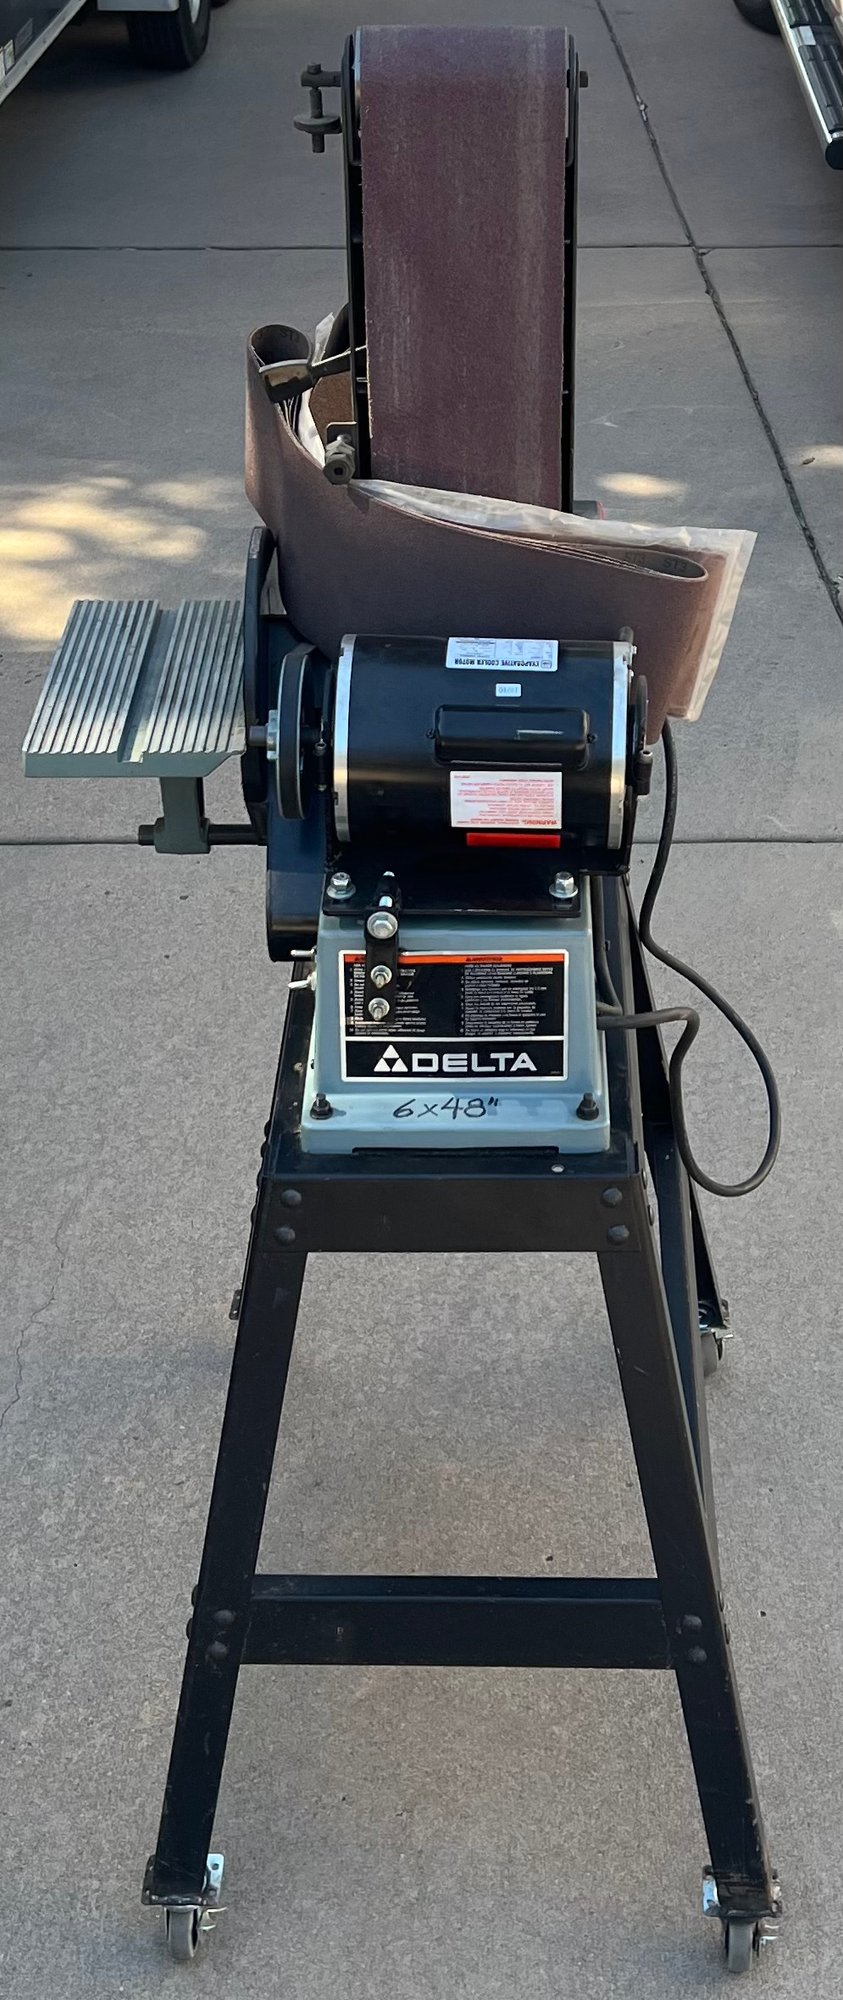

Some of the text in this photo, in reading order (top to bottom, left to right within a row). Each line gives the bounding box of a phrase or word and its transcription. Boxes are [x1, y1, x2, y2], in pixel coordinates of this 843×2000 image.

[454, 657, 475, 666] MOTOR
[476, 659, 499, 667] COOLER
[501, 659, 540, 668] EVAPORATIVE
[411, 1052, 537, 1073] DELTA
